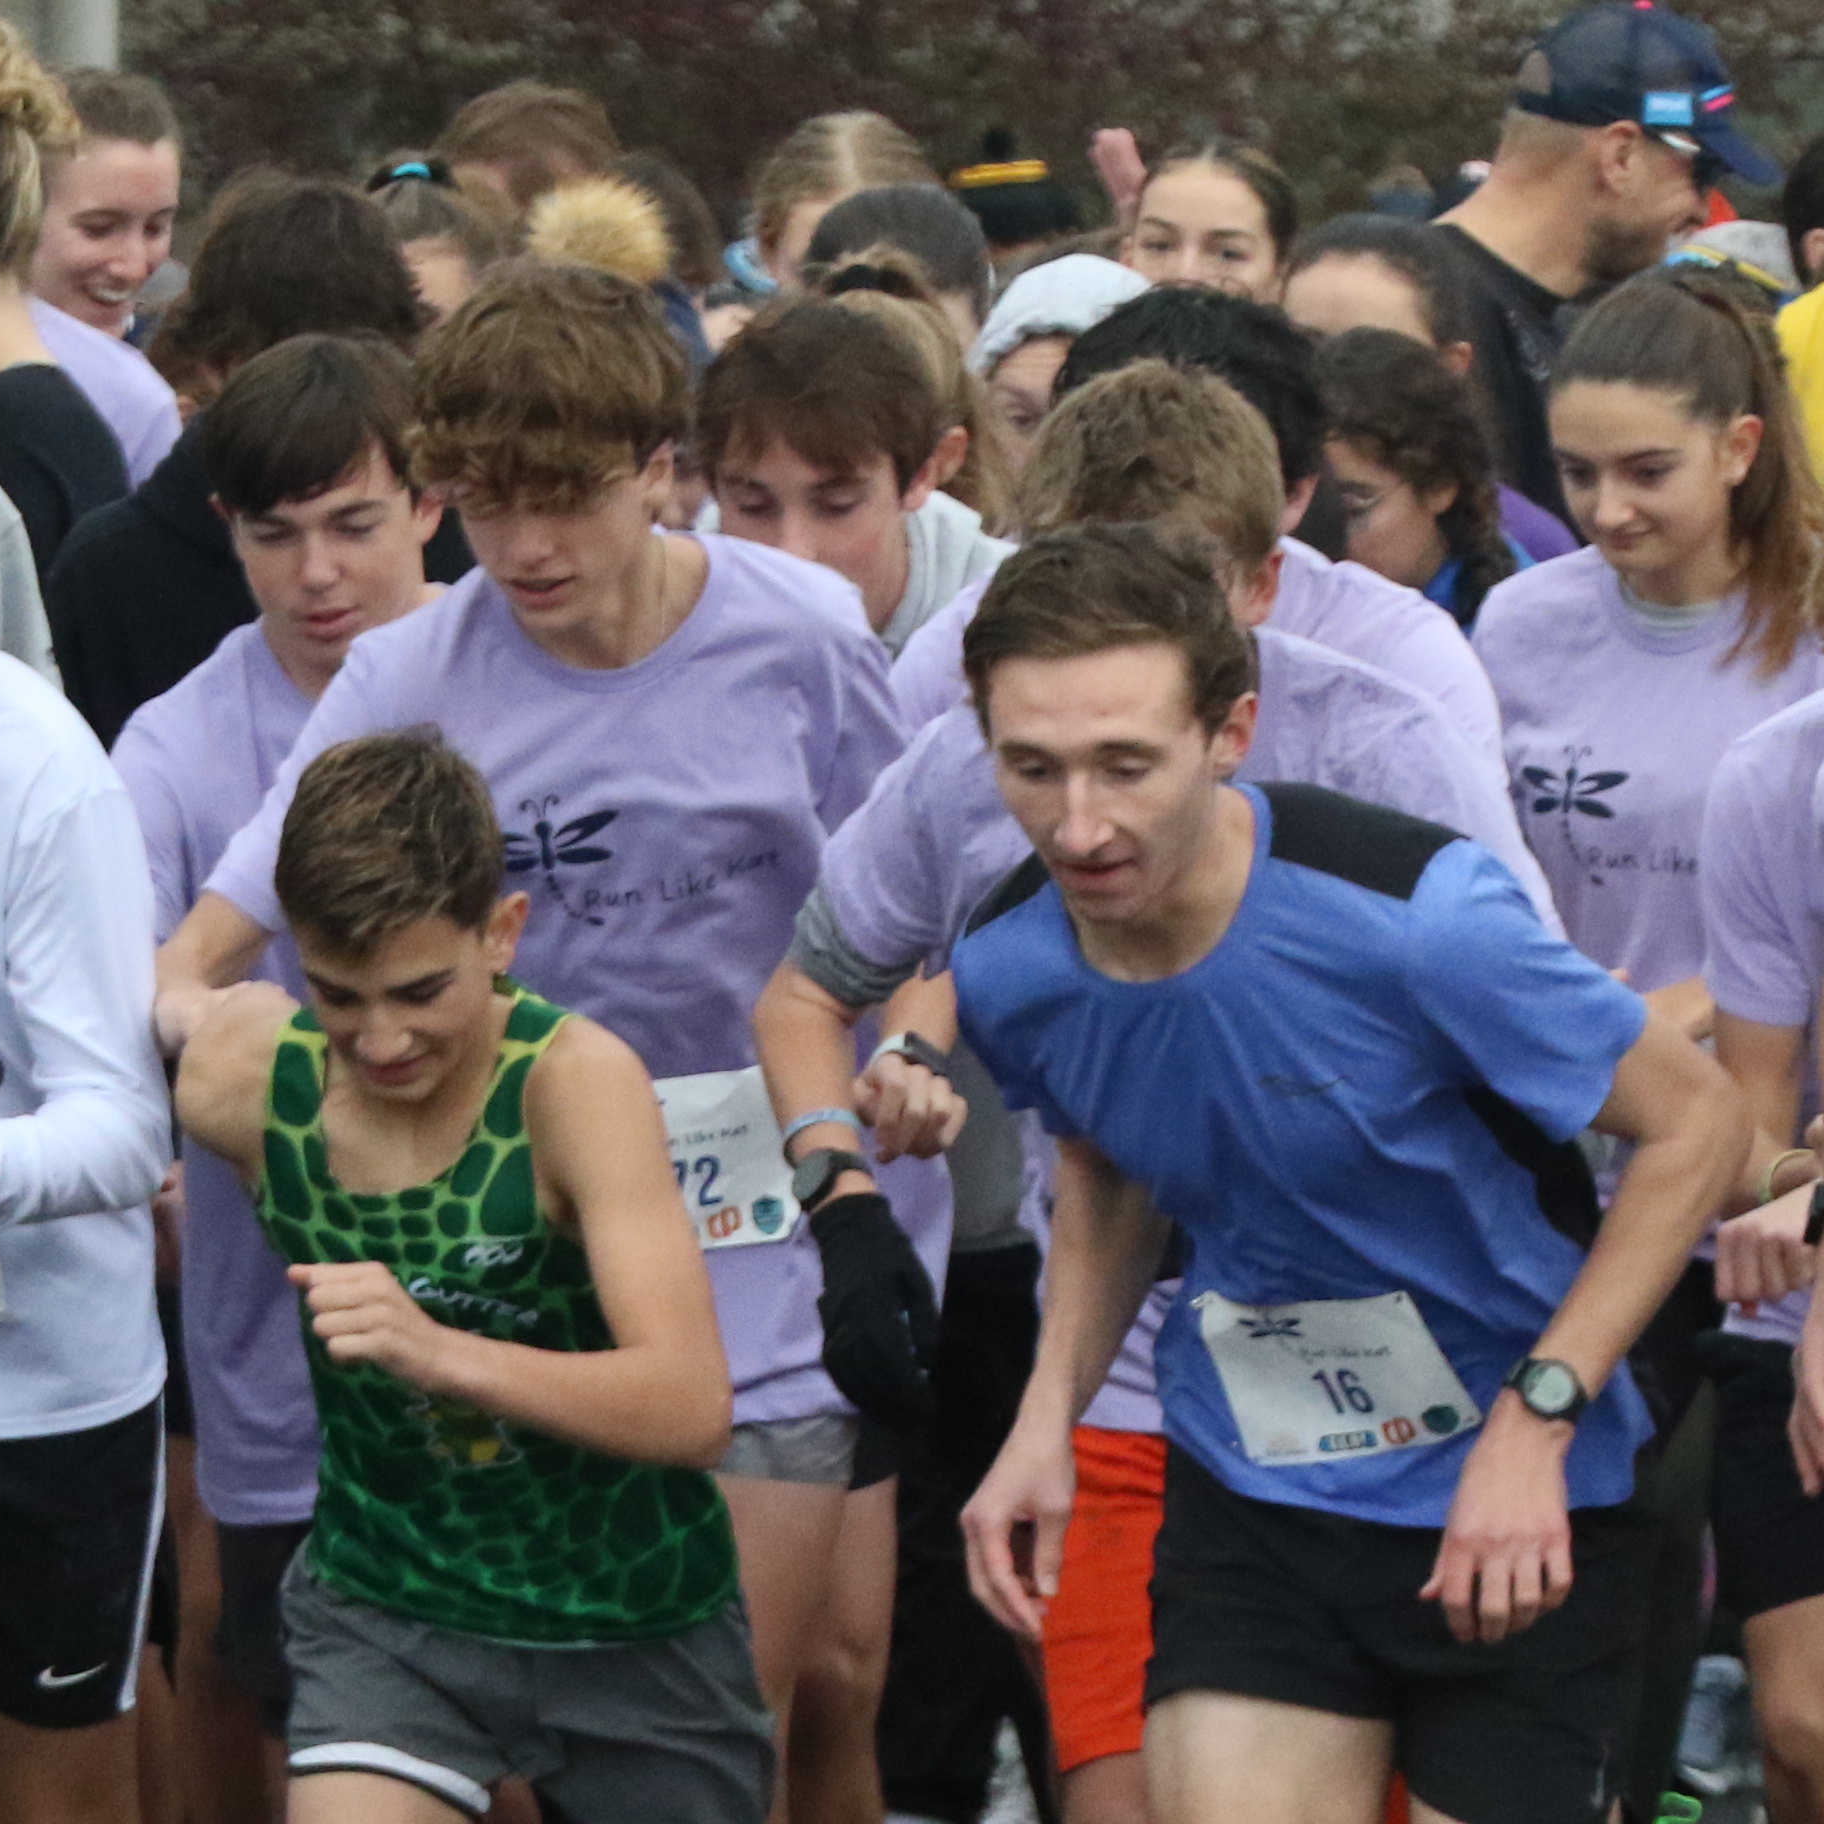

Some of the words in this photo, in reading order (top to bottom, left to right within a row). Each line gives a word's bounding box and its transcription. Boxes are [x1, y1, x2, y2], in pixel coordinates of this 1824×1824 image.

[584, 889, 642, 907] Run
[660, 871, 717, 902] Like
[727, 851, 779, 878] Kat
[1587, 846, 1641, 870] Run
[1311, 1368, 1376, 1415] 16
